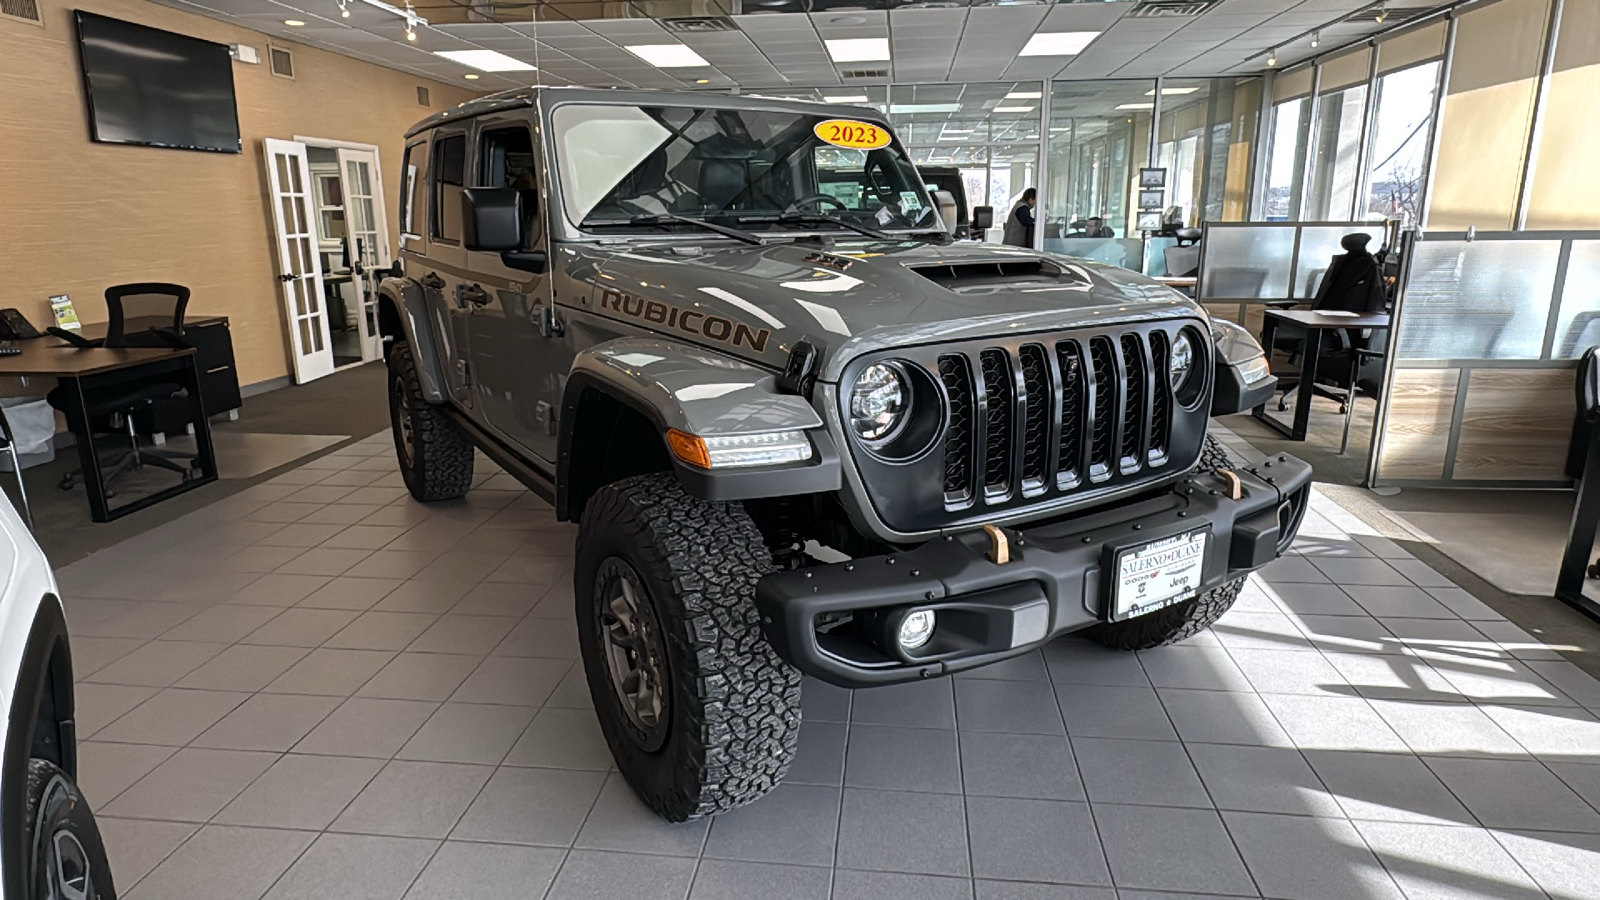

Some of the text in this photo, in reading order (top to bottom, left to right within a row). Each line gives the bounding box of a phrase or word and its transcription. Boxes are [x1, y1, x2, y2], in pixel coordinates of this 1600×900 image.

[829, 125, 878, 144] 2023
[600, 289, 771, 353] RUBICON
[1121, 553, 1167, 576] SALERNO
[1170, 542, 1203, 562] DUANE
[1169, 576, 1189, 588] Jeep
[1128, 589, 1196, 619] SALERNO DUANE
